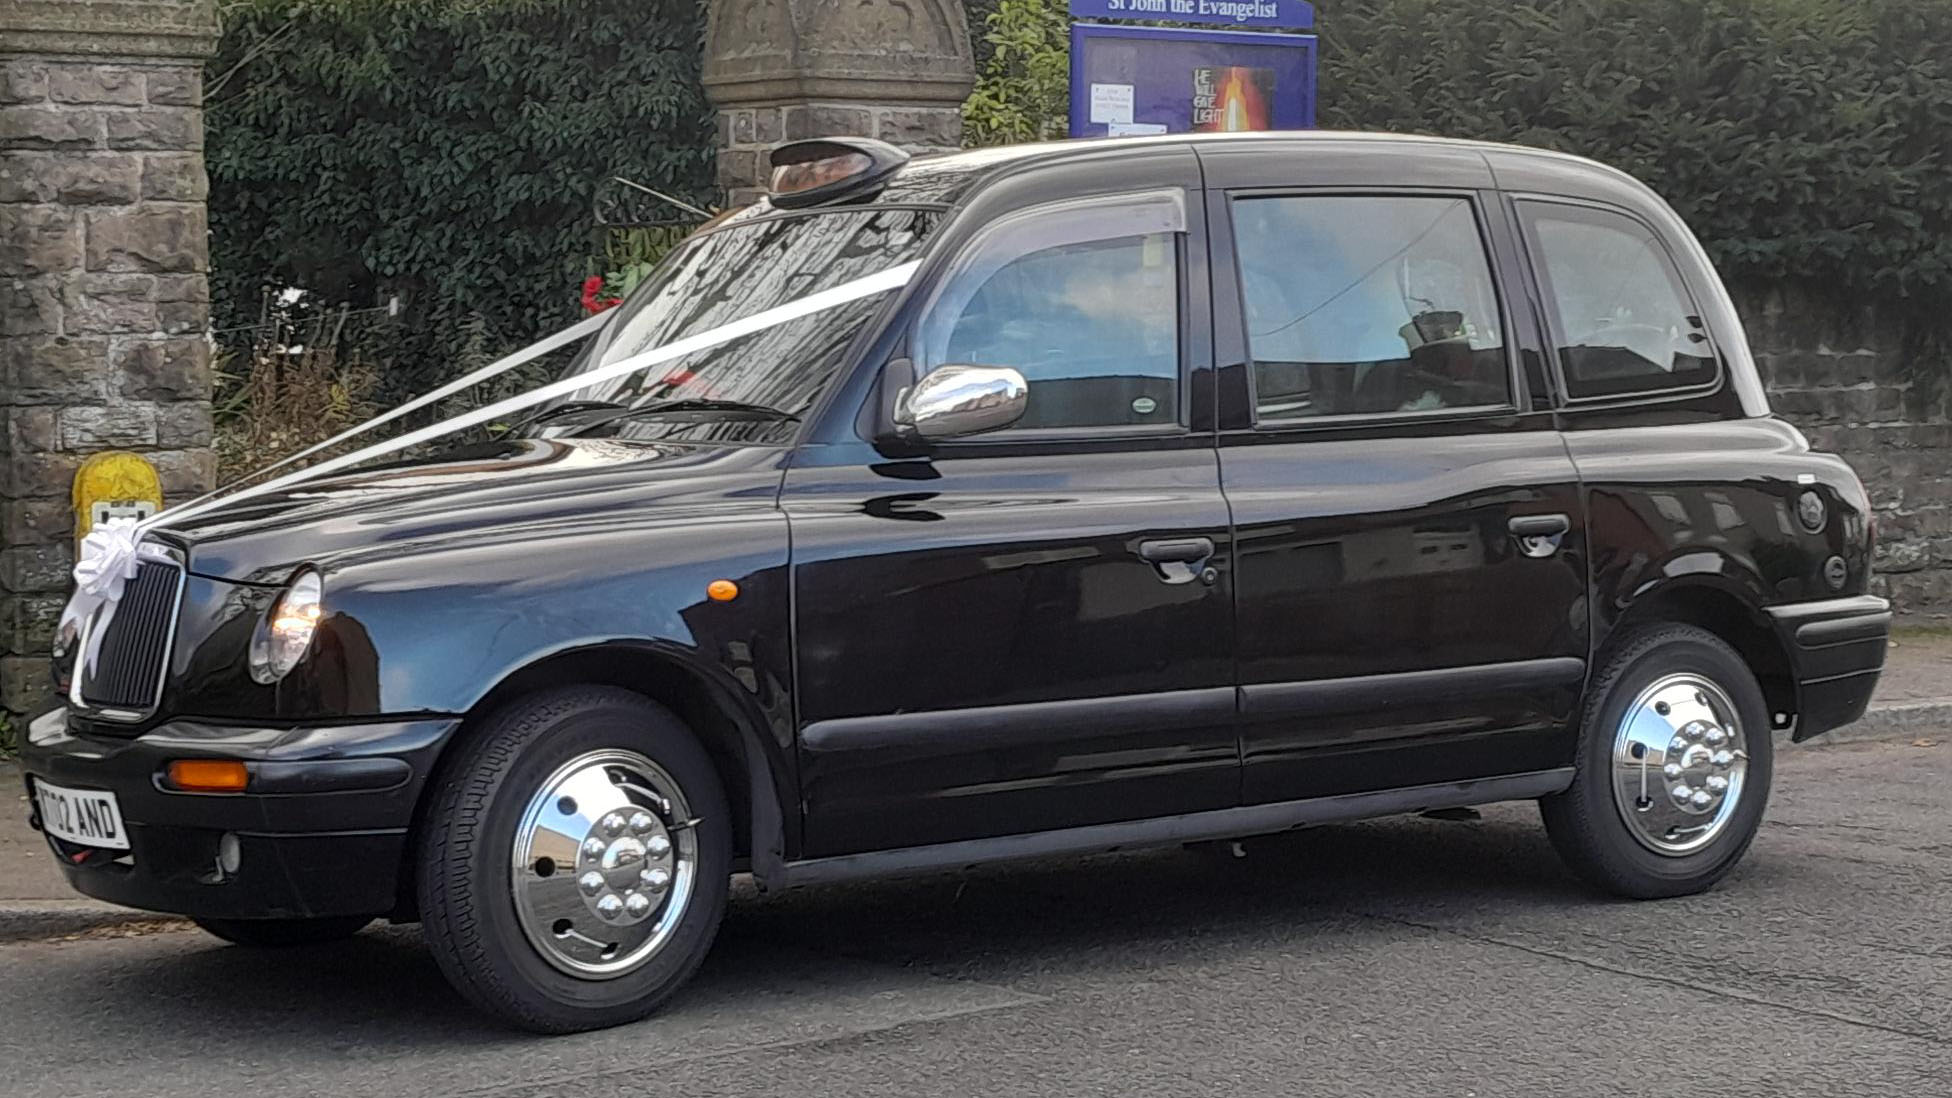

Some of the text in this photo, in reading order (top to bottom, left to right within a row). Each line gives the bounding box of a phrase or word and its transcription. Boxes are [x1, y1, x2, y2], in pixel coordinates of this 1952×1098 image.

[1129, 0, 1167, 12] John
[1170, 0, 1194, 14] the
[1199, 0, 1278, 21] Evangelist
[73, 796, 116, 839] AND
